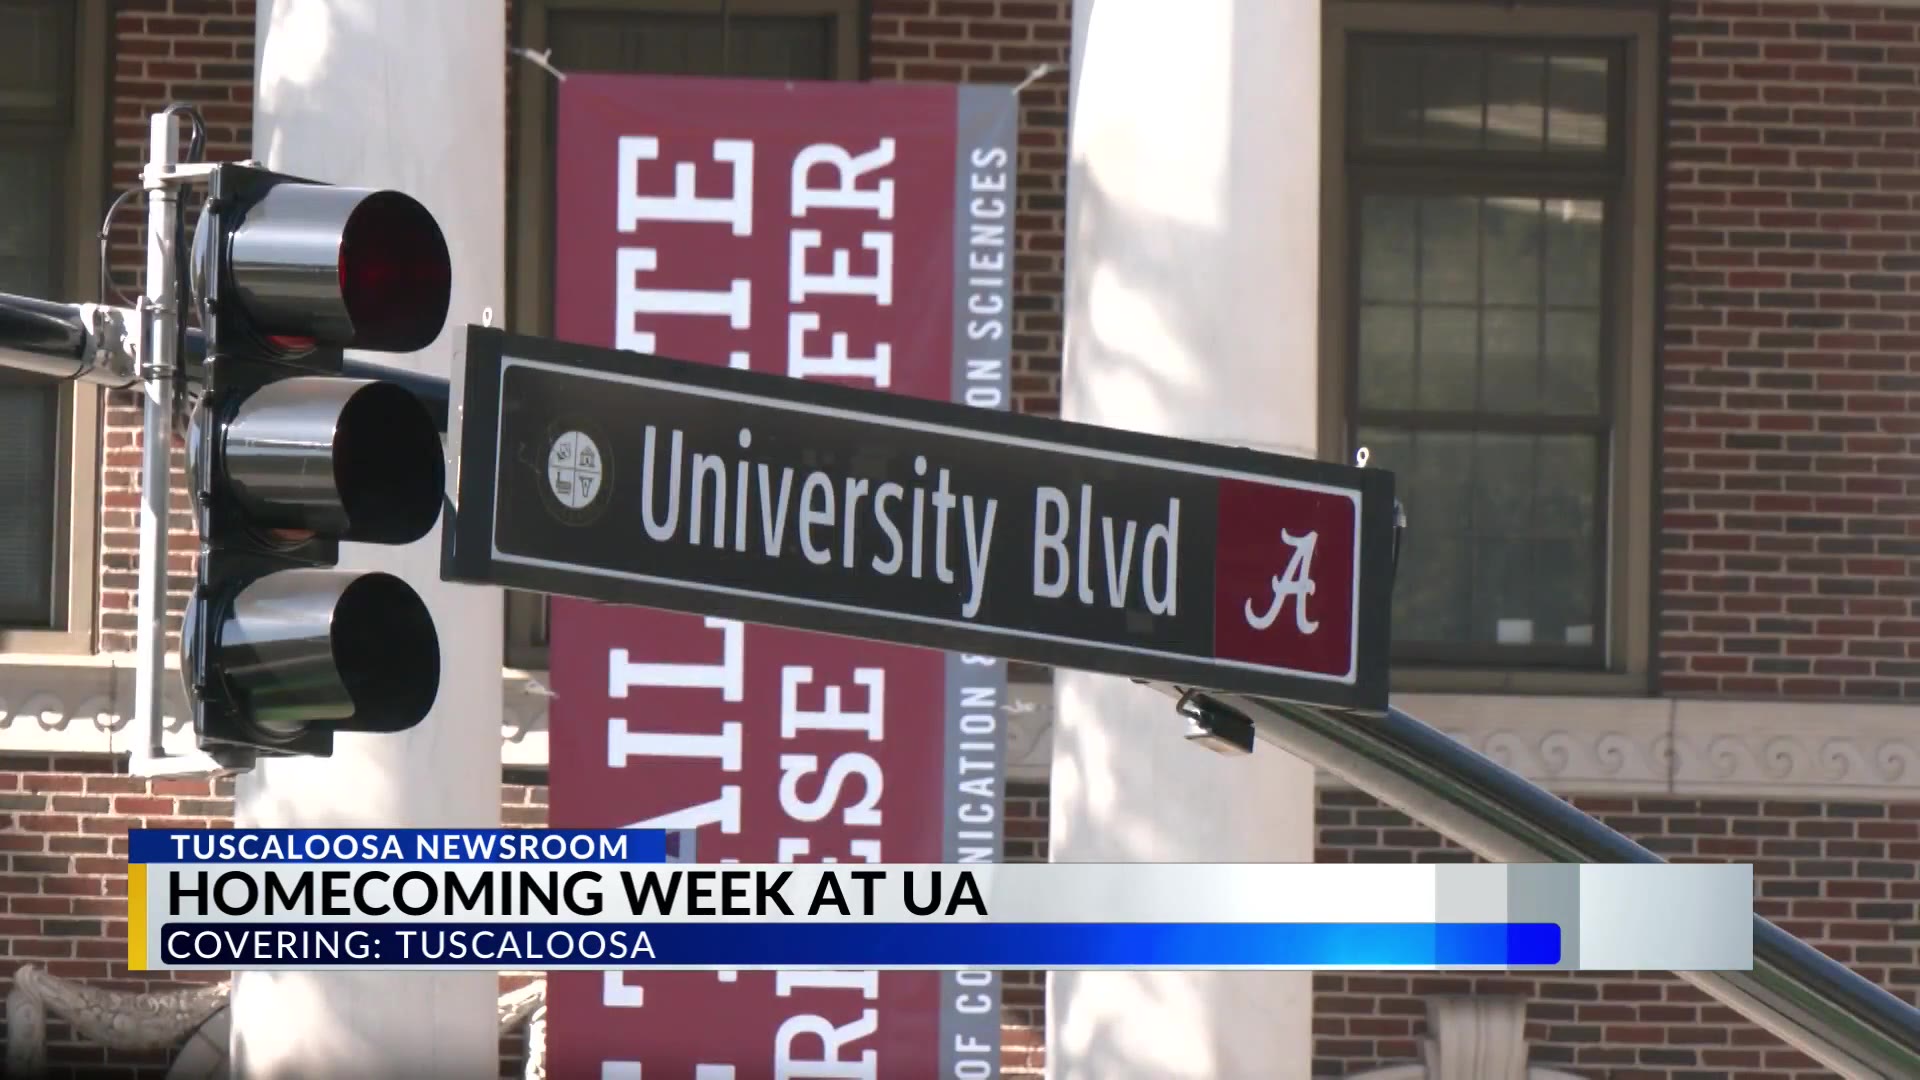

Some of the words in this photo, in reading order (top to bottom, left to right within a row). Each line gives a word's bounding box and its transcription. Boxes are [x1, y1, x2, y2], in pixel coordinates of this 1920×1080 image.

[968, 146, 1008, 340] SCIENCES
[641, 425, 998, 618] University
[1033, 484, 1180, 616] Blvd
